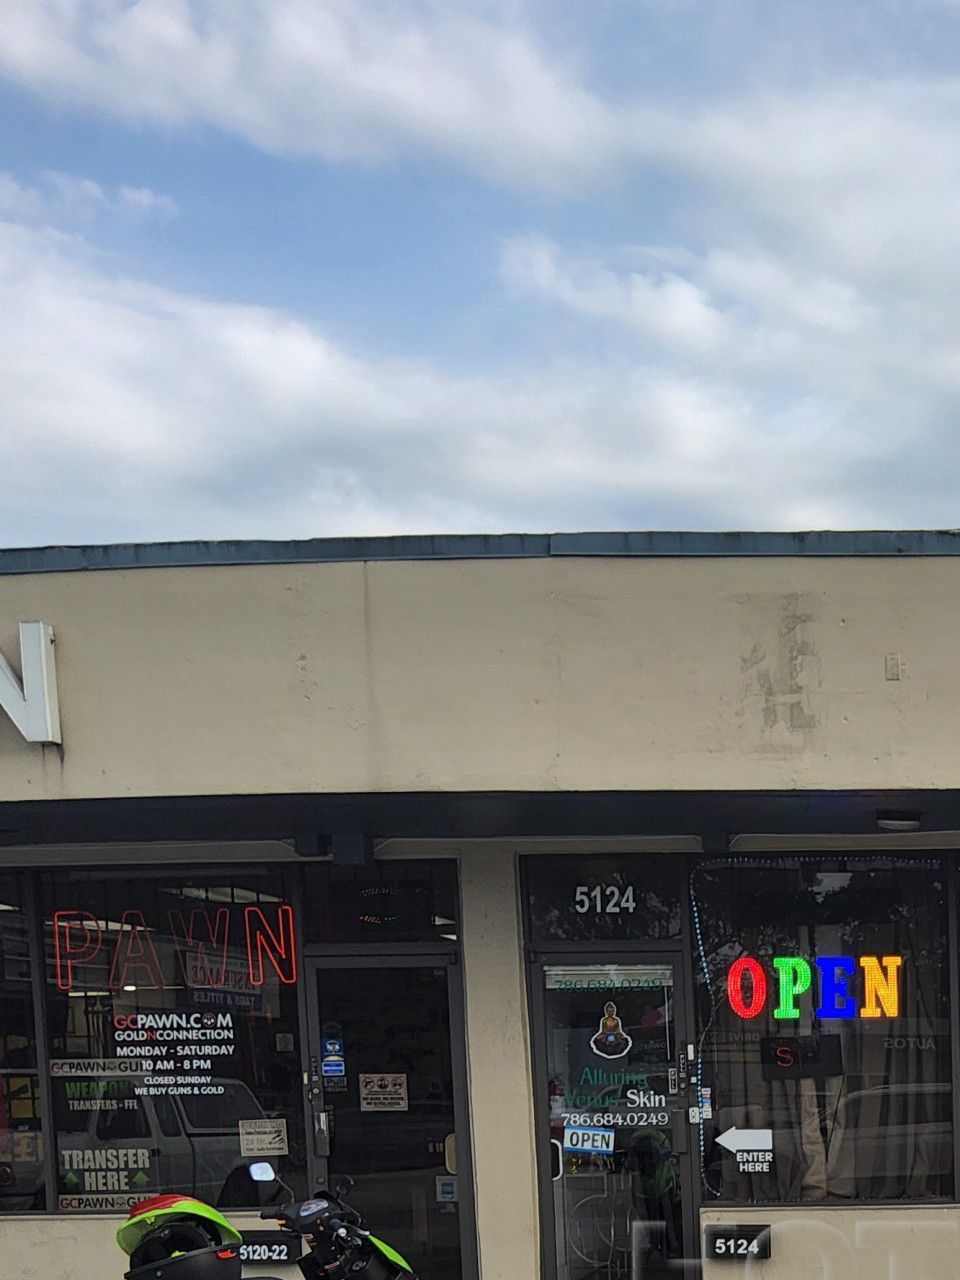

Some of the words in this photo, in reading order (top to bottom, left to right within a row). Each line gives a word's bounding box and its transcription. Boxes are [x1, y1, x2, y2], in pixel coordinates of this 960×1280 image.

[575, 885, 636, 913] 5124
[54, 906, 297, 989] PAWN
[555, 978, 663, 993] 786.684.0249
[727, 956, 902, 1019] OPEN
[114, 1029, 234, 1042] GOLDNCONNECTION
[116, 1046, 168, 1057] MONDAY
[177, 1045, 235, 1056] SATURDAY
[52, 1060, 107, 1074] GCPAWN
[142, 1060, 153, 1070] 10
[156, 1060, 174, 1070] AM
[183, 1060, 191, 1070] 8
[193, 1060, 211, 1070] PM
[144, 1076, 175, 1084] CLOSED
[176, 1076, 211, 1084] SUNDAY
[580, 1067, 649, 1089] Alluring
[134, 1087, 149, 1095] WE
[150, 1087, 166, 1095] BUY
[168, 1086, 192, 1095] GUNS
[193, 1086, 199, 1094] &
[201, 1086, 224, 1095] GOLD
[68, 1100, 118, 1110] TRANSFERS
[124, 1099, 139, 1110] FFL
[626, 1089, 666, 1108] Skin
[561, 1112, 669, 1126] 786.684.0249
[569, 1131, 611, 1149] OPEN
[62, 1148, 150, 1169] TRANSFER
[736, 1152, 773, 1162] ENTER
[739, 1162, 770, 1172] HERE
[84, 1171, 130, 1191] HERE
[60, 1197, 115, 1209] GCPAWN
[240, 1245, 288, 1260] 5120-22
[715, 1239, 760, 1254] 5124
